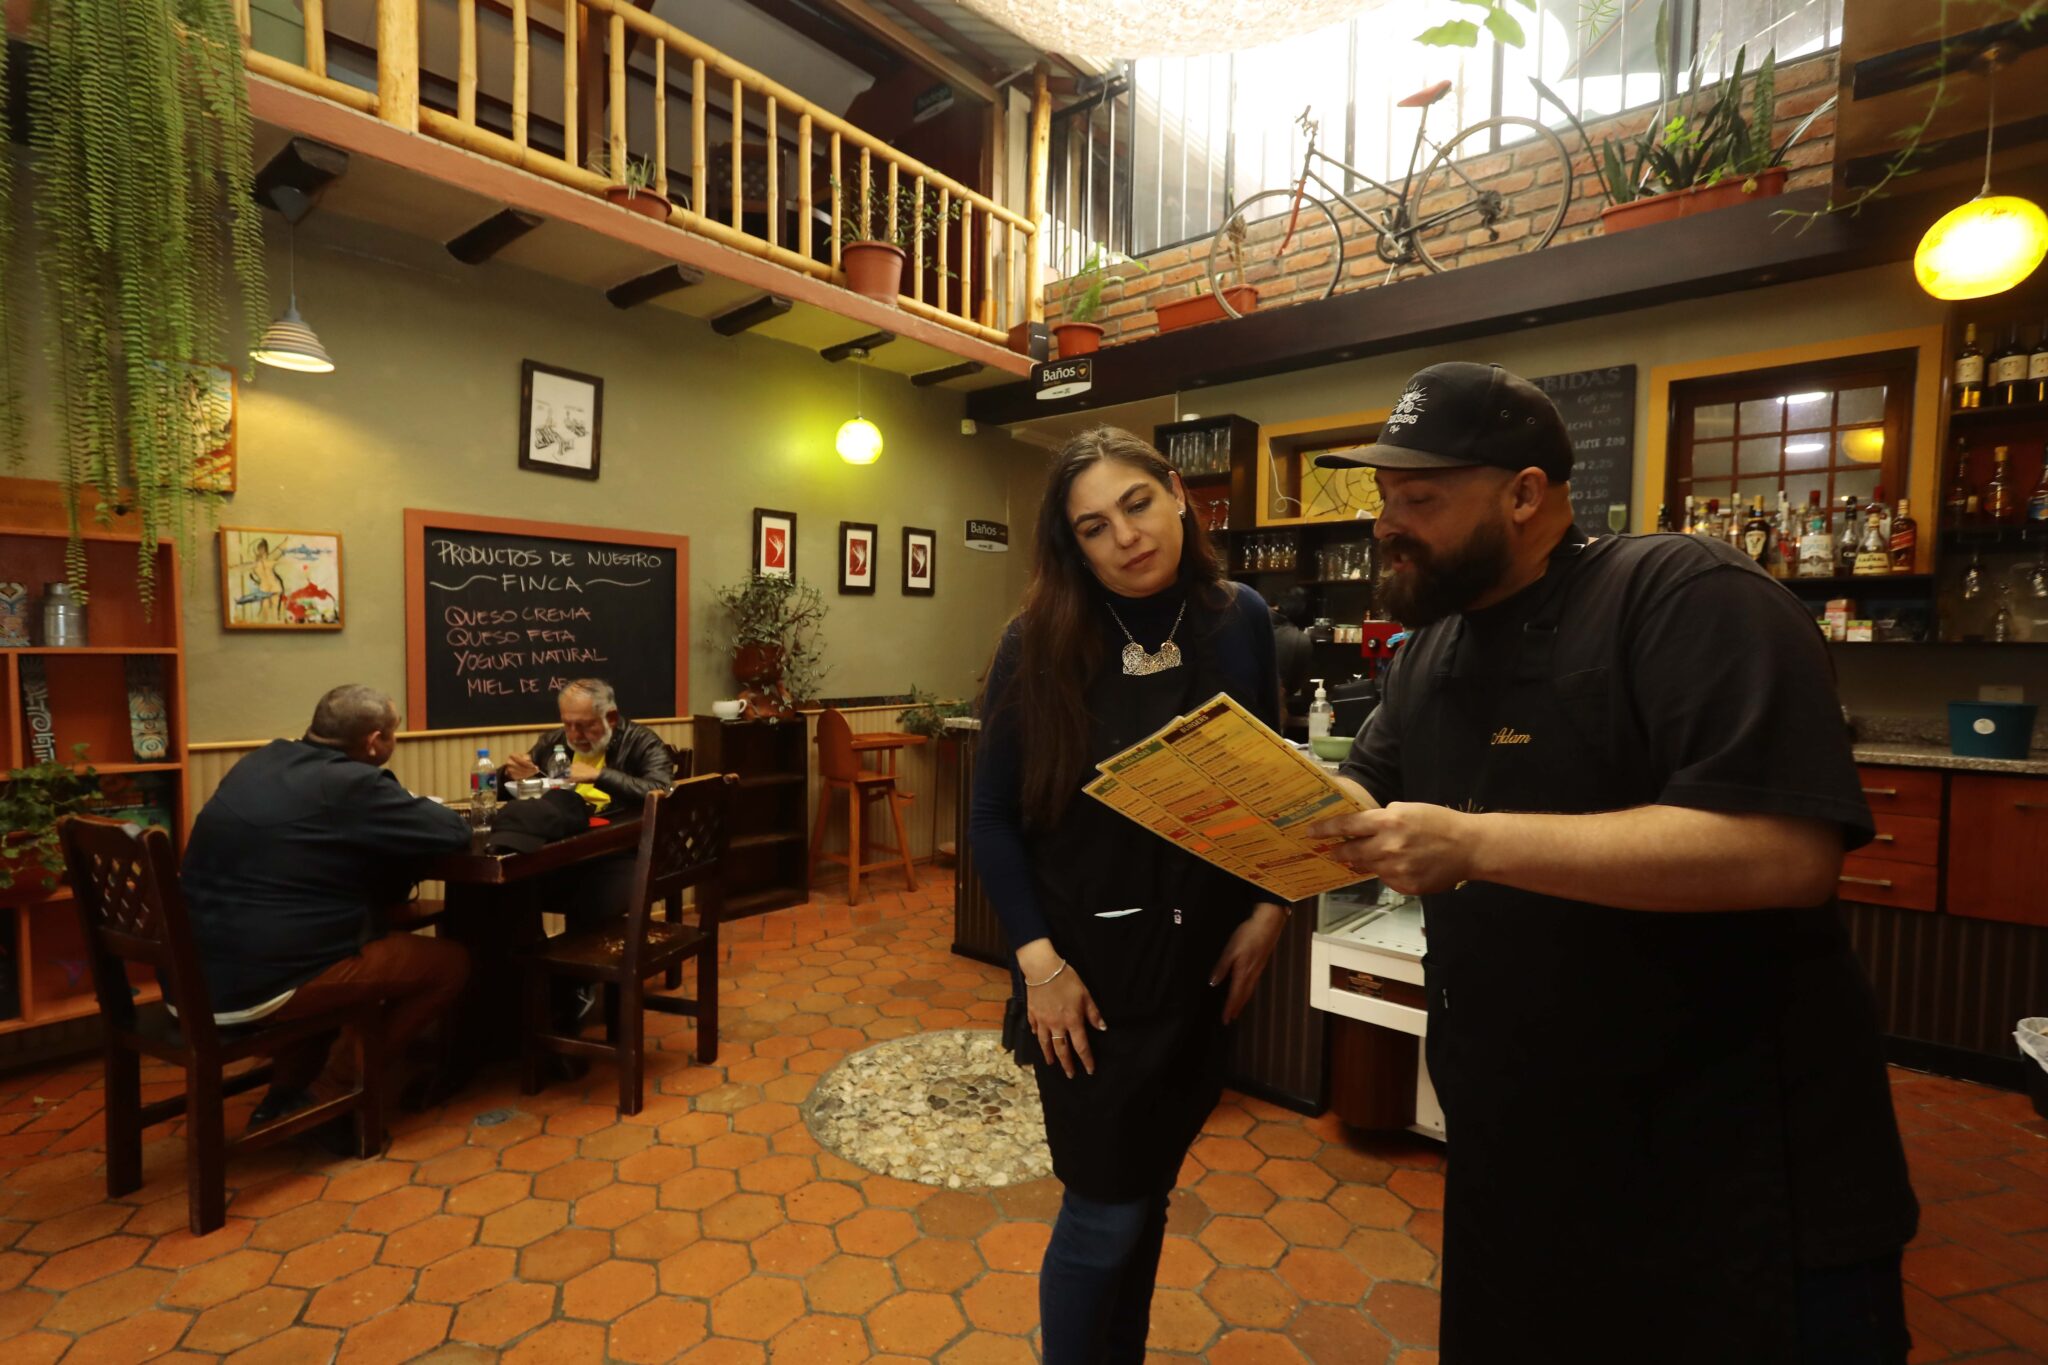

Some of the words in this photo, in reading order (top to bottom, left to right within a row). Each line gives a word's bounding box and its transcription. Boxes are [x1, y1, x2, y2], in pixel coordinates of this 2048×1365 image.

[1043, 366, 1076, 382] Baños
[970, 522, 997, 536] Baños
[432, 540, 542, 568] PRODUCTOS
[550, 550, 575, 567] DE
[588, 551, 662, 569] NUESTRO
[502, 573, 583, 594] FINCA
[445, 606, 518, 628] QUESO
[522, 606, 592, 623] CREMA
[446, 627, 520, 648] QUESO
[526, 629, 576, 643] FETA
[454, 650, 526, 676] YOGURT
[531, 648, 608, 665] NATURAL
[467, 677, 513, 697] MIEL
[519, 677, 540, 694] DE
